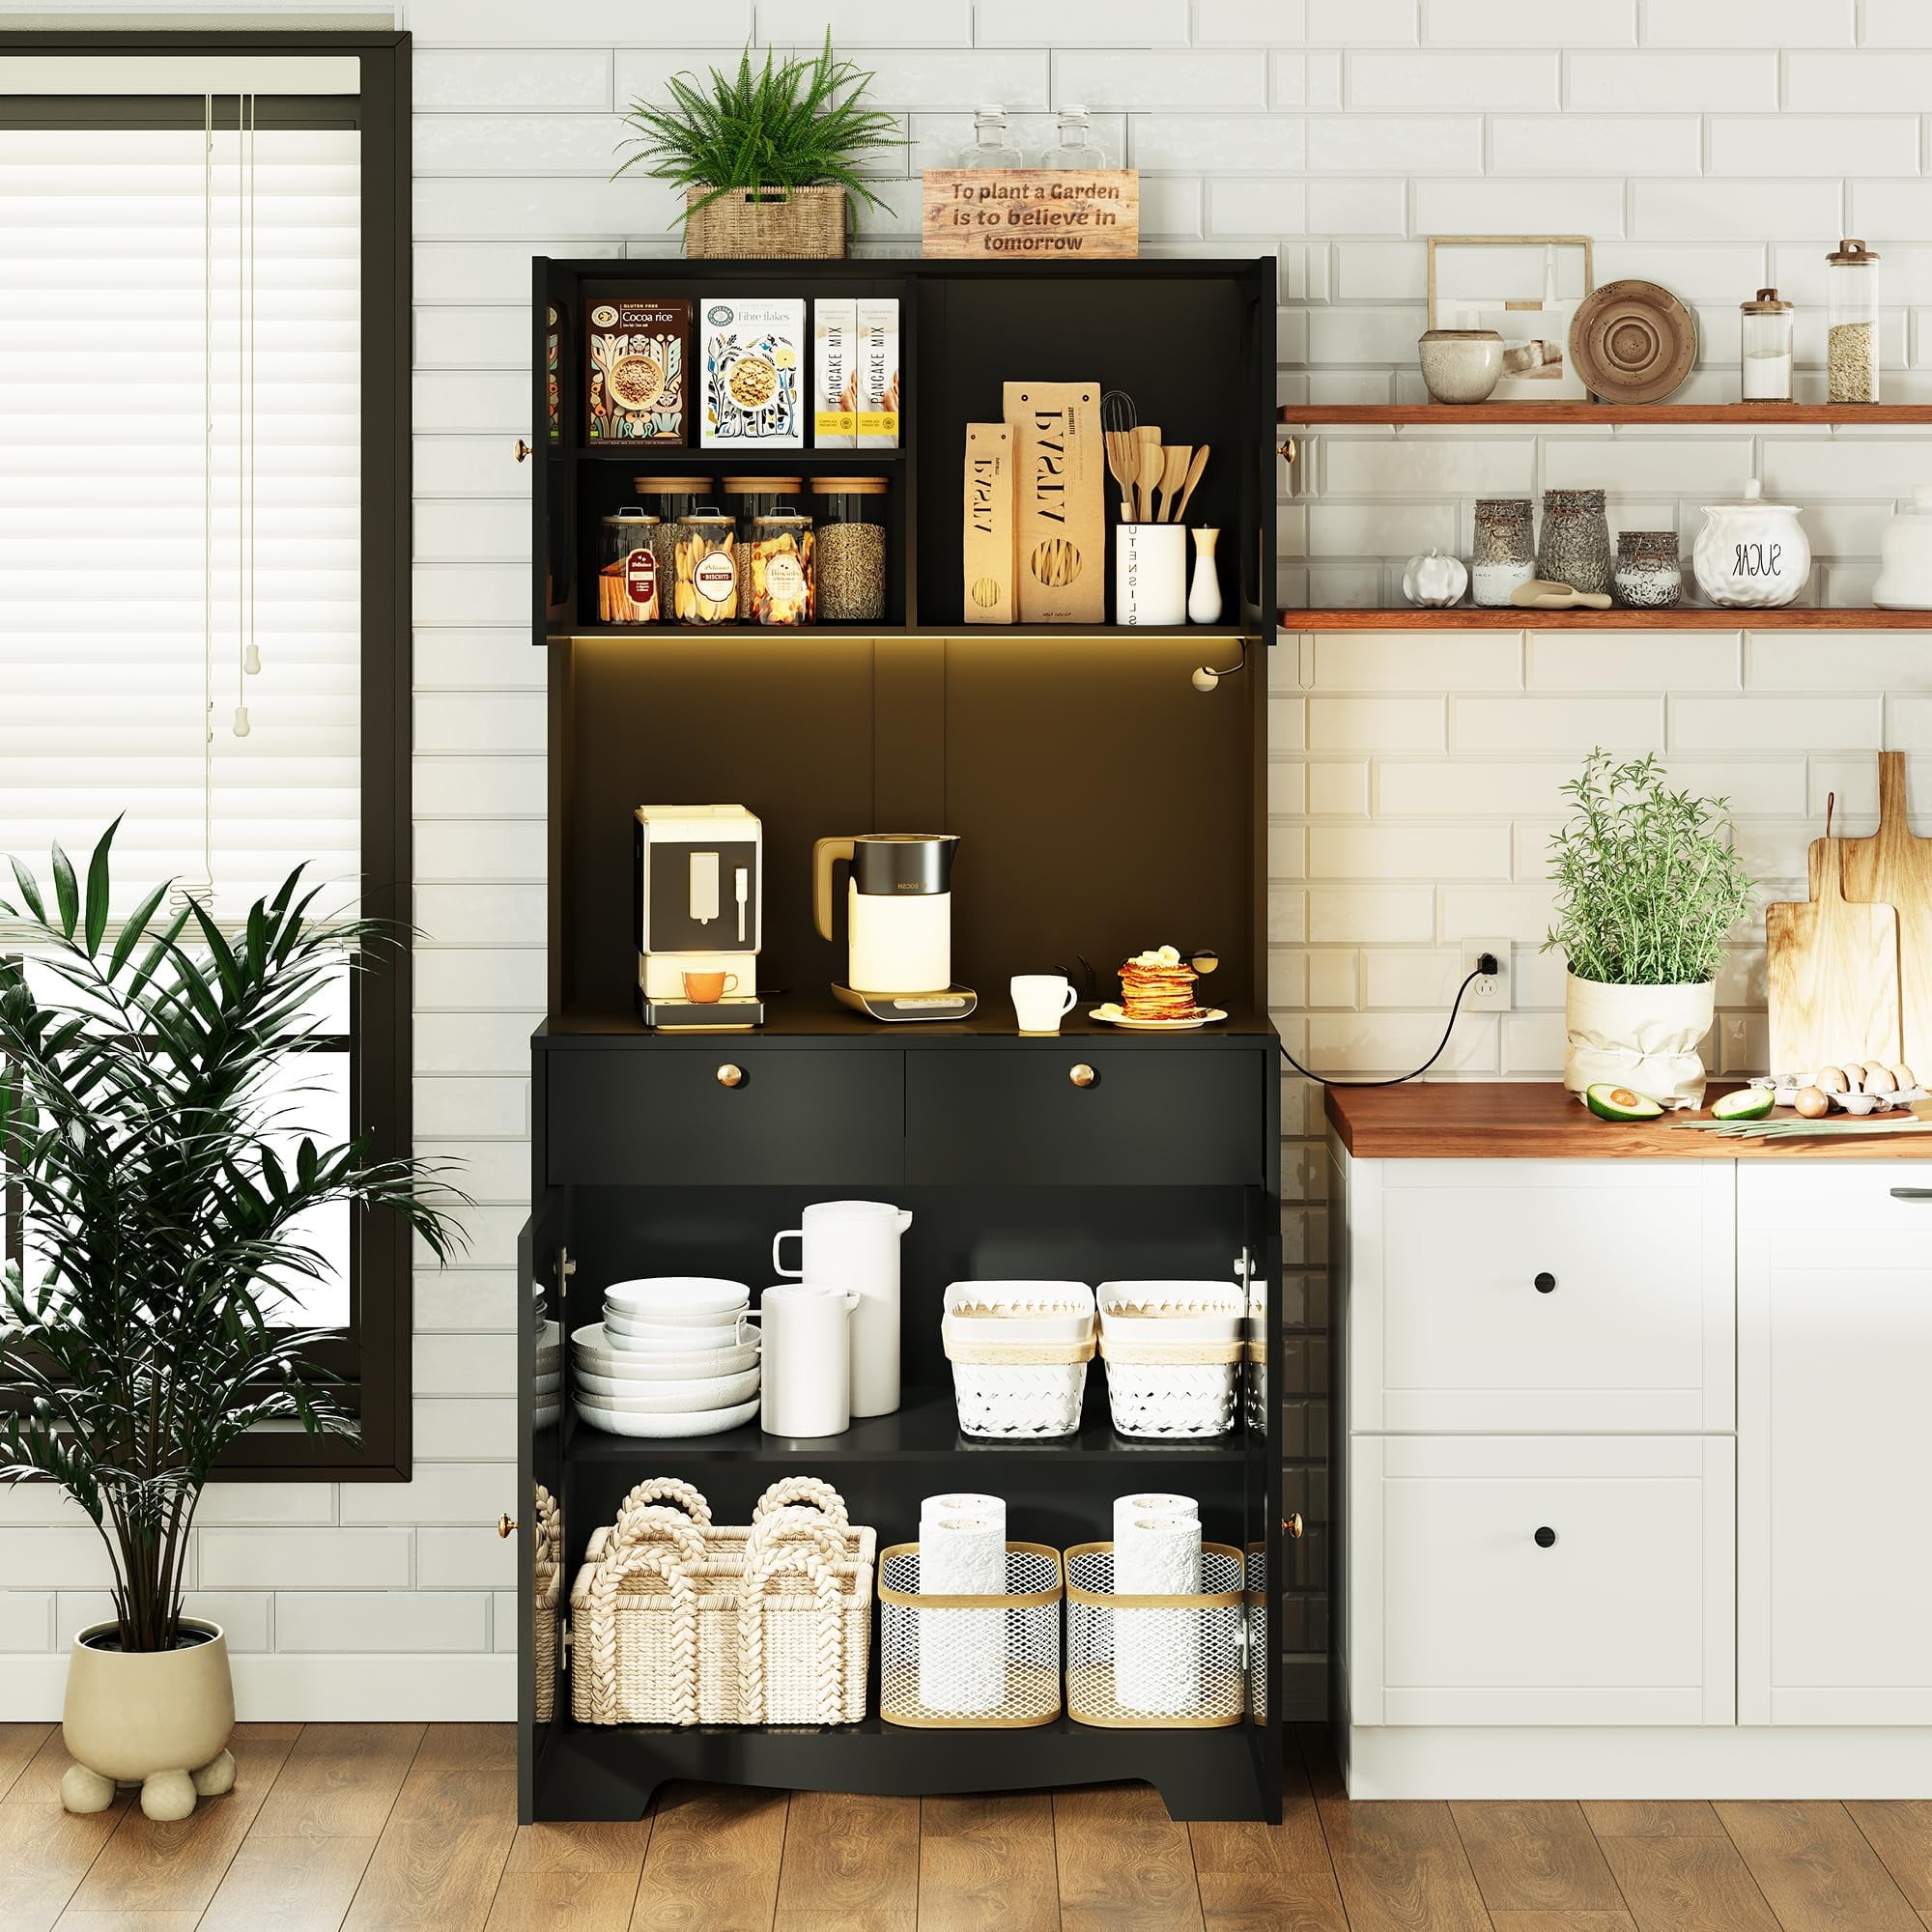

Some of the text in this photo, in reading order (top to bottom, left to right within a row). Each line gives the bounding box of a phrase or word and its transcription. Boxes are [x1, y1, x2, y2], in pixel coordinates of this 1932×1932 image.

[952, 183, 1121, 203] To plant a Garden
[952, 208, 1117, 226] is to believe in
[983, 234, 1084, 250] tomorrow
[622, 312, 653, 322] Cocoa
[655, 311, 673, 322] rice
[738, 311, 790, 322] Fibre flakes
[828, 327, 842, 347] MIX
[870, 327, 885, 347] MIX
[828, 354, 842, 404] PANCAKE
[870, 354, 885, 404] PANCAKE
